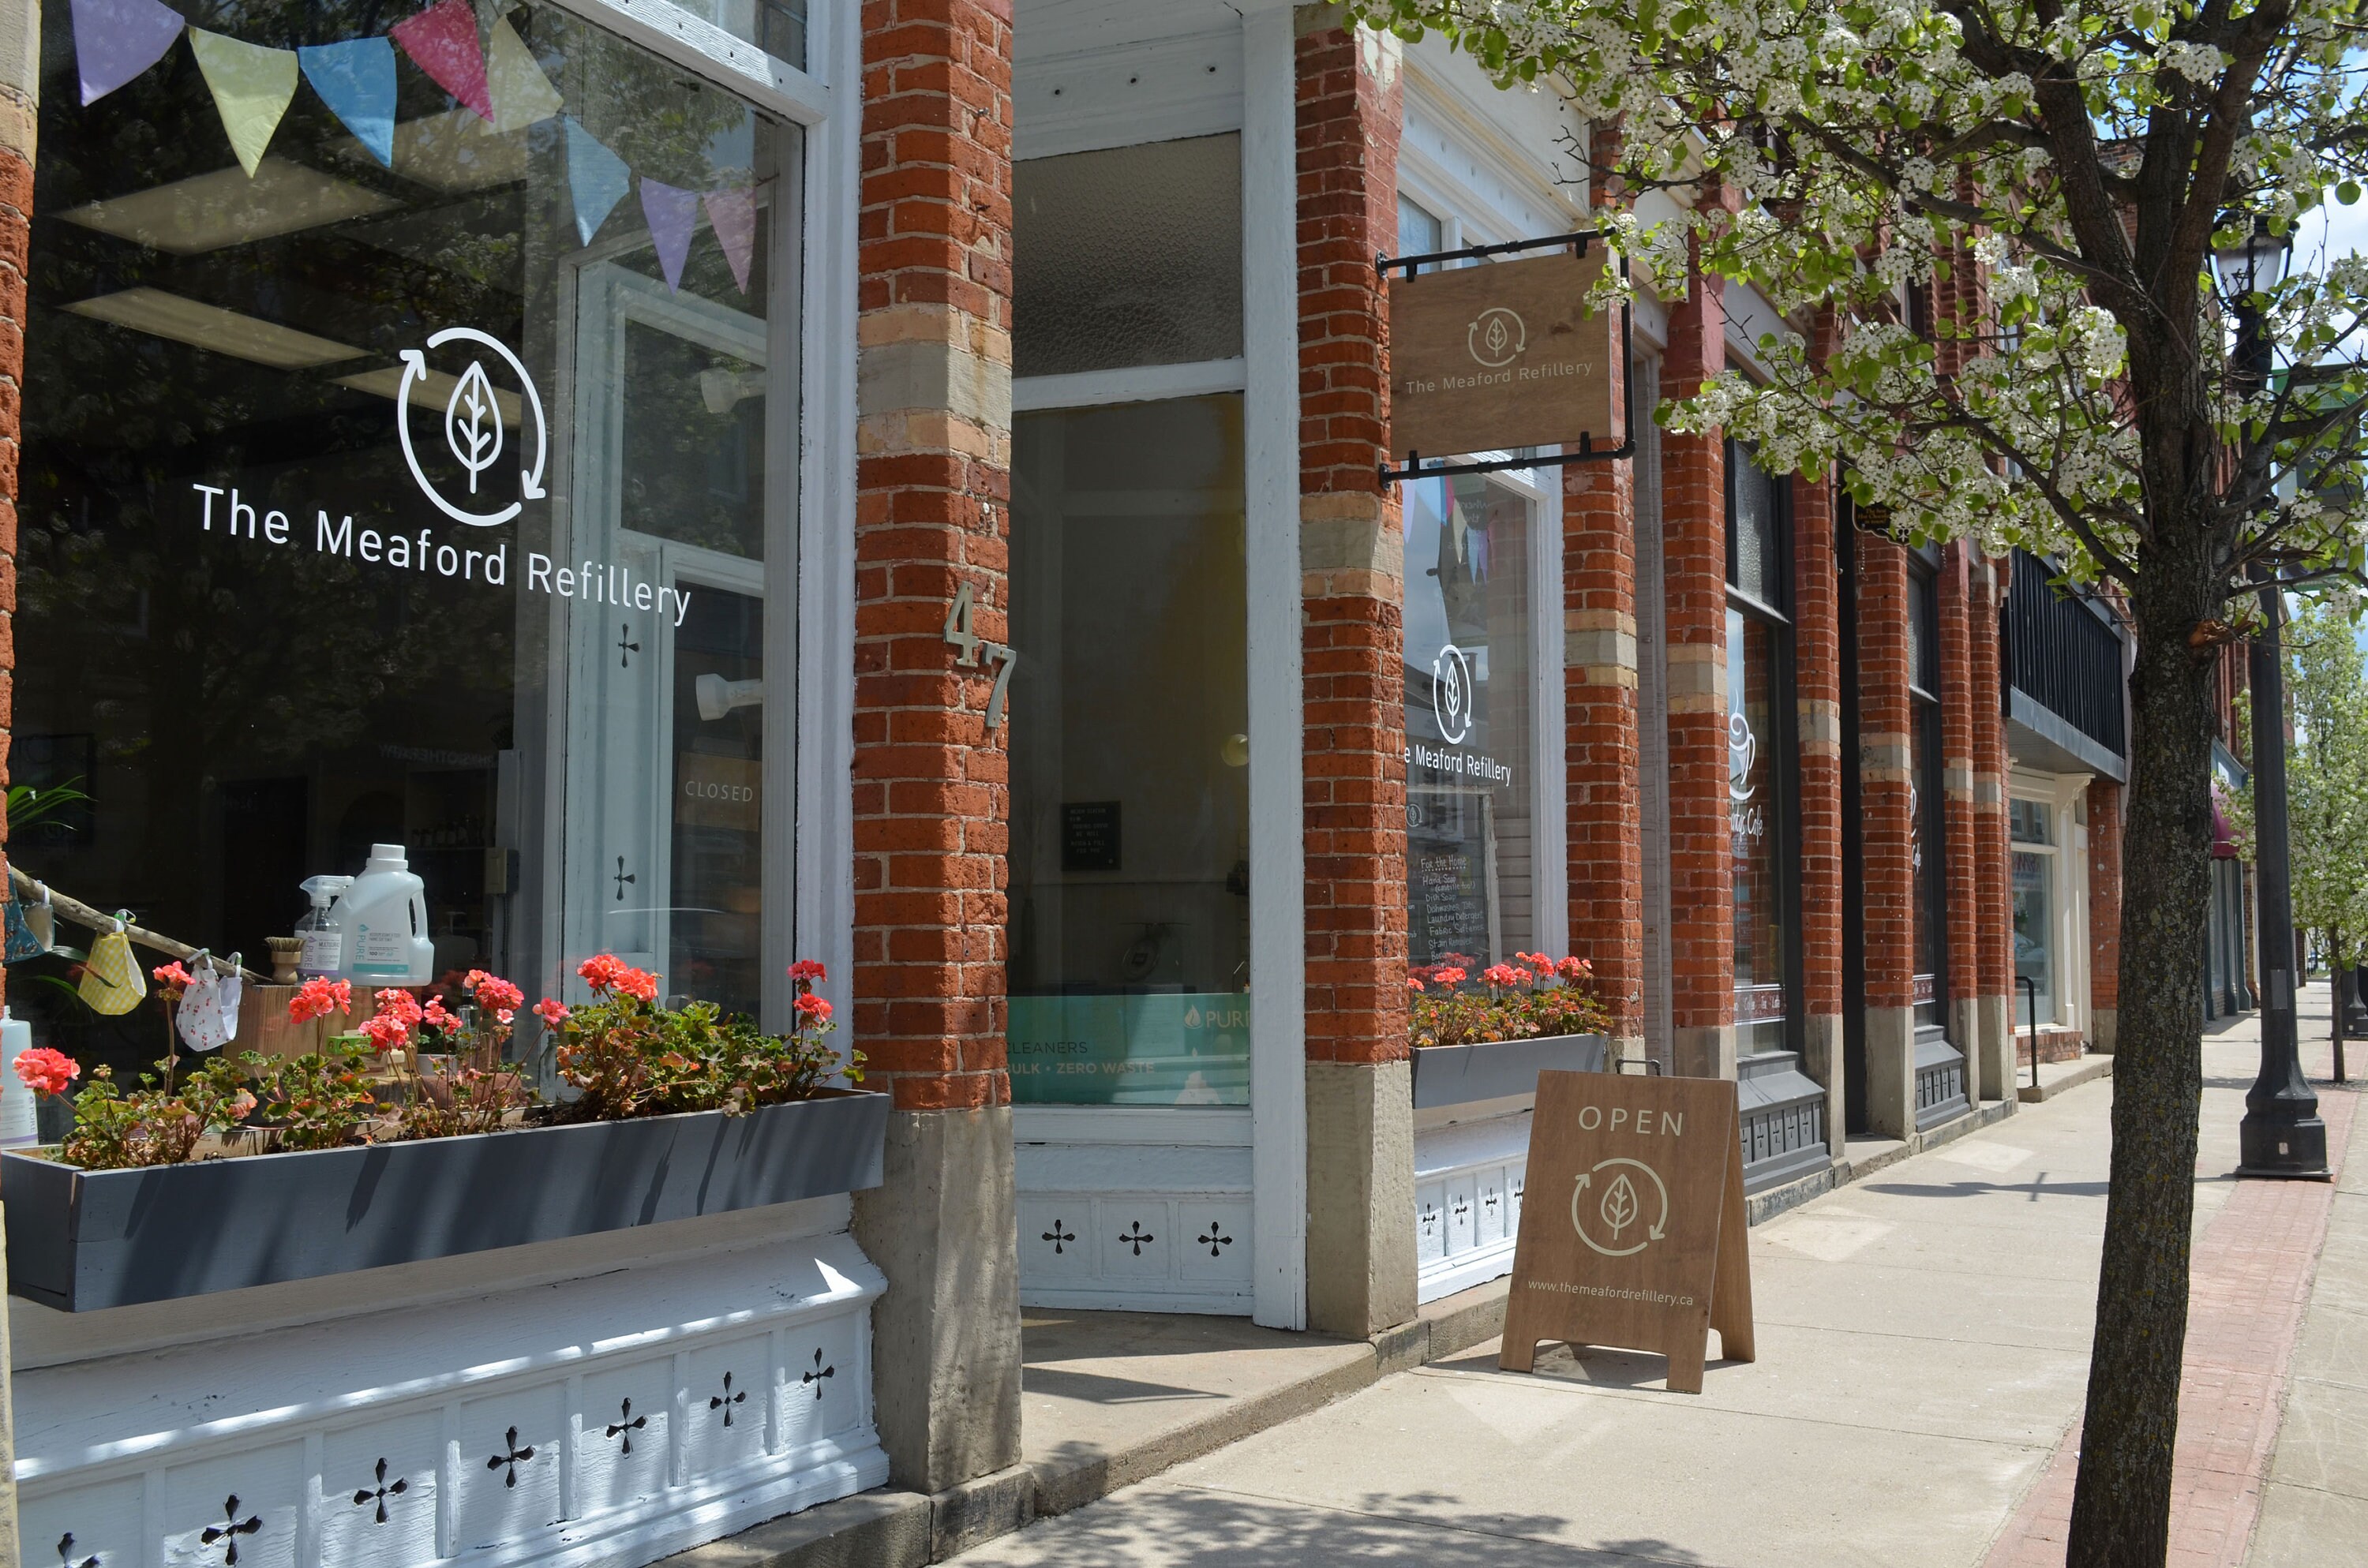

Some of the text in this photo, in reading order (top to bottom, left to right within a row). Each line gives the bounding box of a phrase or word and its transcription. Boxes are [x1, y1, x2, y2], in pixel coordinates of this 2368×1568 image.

[1406, 362, 1593, 394] The Meaford Refillery
[193, 483, 691, 627] The Meaford Refillery
[943, 580, 1017, 728] 47
[1415, 744, 1462, 773] Meaford
[1467, 754, 1512, 788] Refillery
[685, 780, 753, 802] CLOSED
[1448, 854, 1467, 867] Home
[1422, 874, 1441, 885] Hand
[1426, 893, 1456, 902] Dish Soap
[356, 934, 366, 960] PURE
[1428, 938, 1448, 949] Stain
[303, 945, 314, 968] PURE
[1056, 1062, 1096, 1074] ZERO
[1102, 1061, 1155, 1074] WASTE
[1579, 1106, 1683, 1136] OPEN
[1528, 1280, 1694, 1307] www.themeafordrefillery.ca
